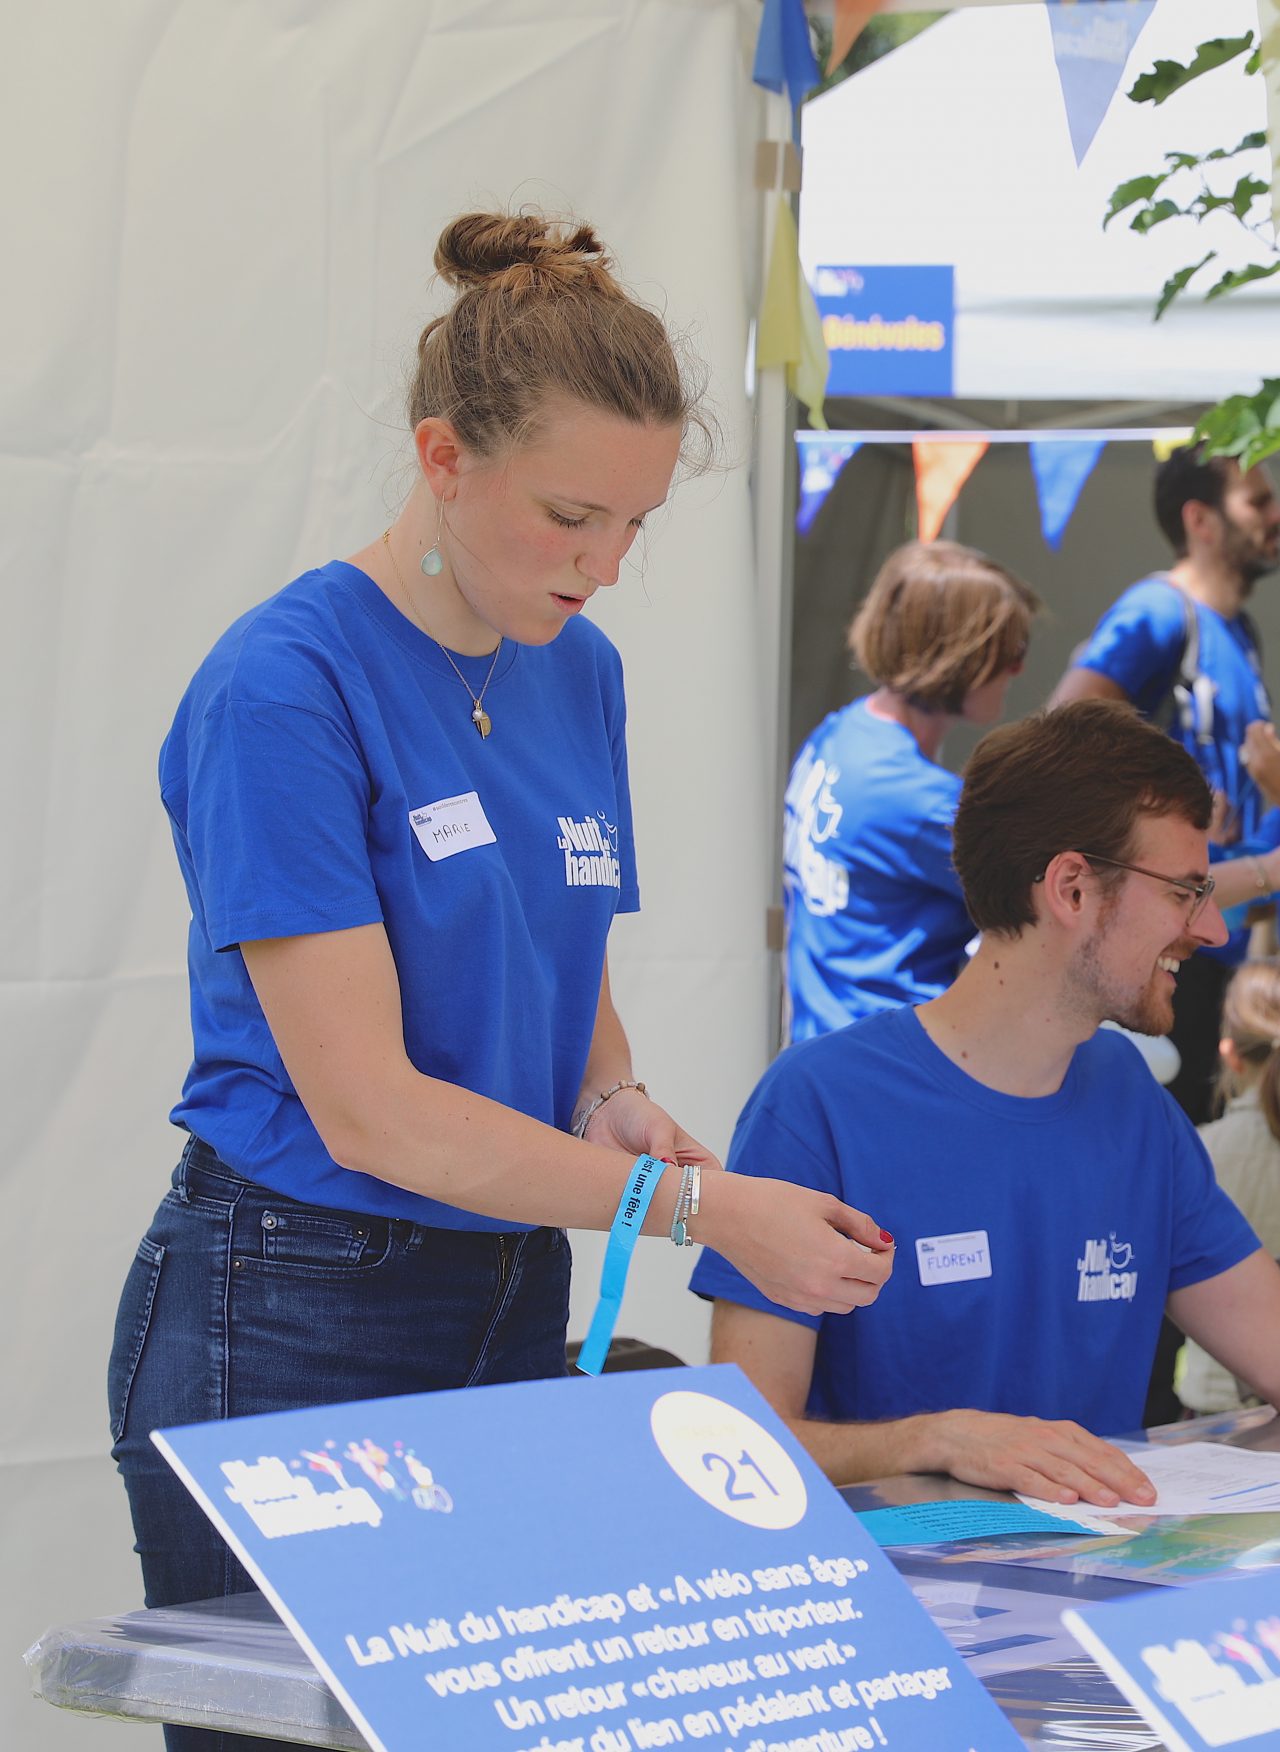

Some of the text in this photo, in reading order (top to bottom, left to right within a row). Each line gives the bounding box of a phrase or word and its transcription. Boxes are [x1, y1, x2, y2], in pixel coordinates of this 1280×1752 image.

[432, 823, 471, 844] MARIE
[557, 815, 604, 852] Nuit
[564, 847, 620, 889] handic
[632, 1173, 648, 1195] une
[624, 1197, 641, 1219] fête
[927, 1248, 985, 1270] FLORENT
[701, 1448, 780, 1502] 21
[345, 1634, 395, 1667] La
[389, 1618, 459, 1657] Nuit
[459, 1611, 502, 1644] du
[497, 1593, 626, 1636] handicap
[626, 1582, 660, 1612] et
[696, 1568, 753, 1600] vélo
[752, 1563, 811, 1592] sans
[425, 1597, 864, 1698] vous offrent un retour en triporteur.
[494, 1695, 547, 1731] Un
[544, 1681, 628, 1721] retour
[753, 1651, 791, 1679] au
[589, 1725, 632, 1752] du
[626, 1717, 684, 1750] lien
[682, 1708, 722, 1739] en
[719, 1684, 832, 1738] pédalant
[828, 1679, 860, 1708] et
[856, 1666, 953, 1710] partager
